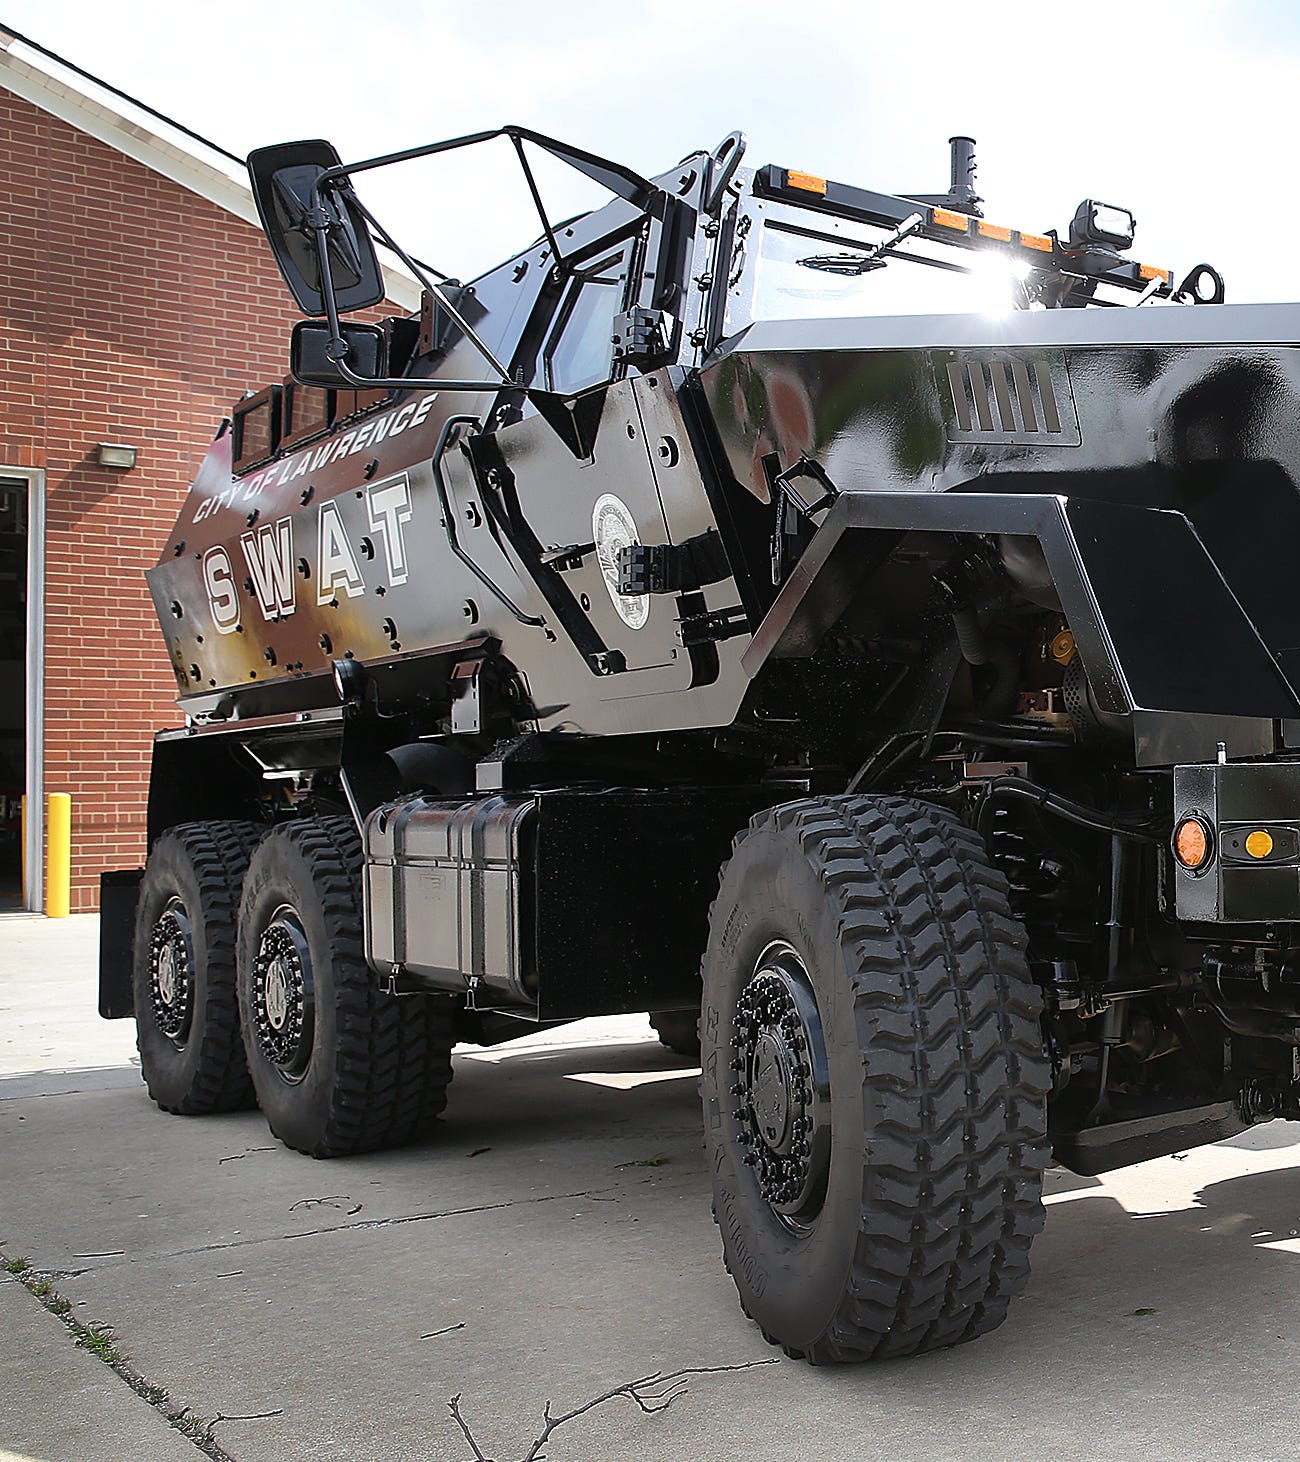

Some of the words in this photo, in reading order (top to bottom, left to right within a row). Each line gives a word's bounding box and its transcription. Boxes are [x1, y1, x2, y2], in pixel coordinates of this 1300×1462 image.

[192, 481, 241, 524] CITY
[243, 469, 280, 501] OF
[276, 392, 439, 487] LAWRENCE
[202, 471, 413, 635] SWAT
